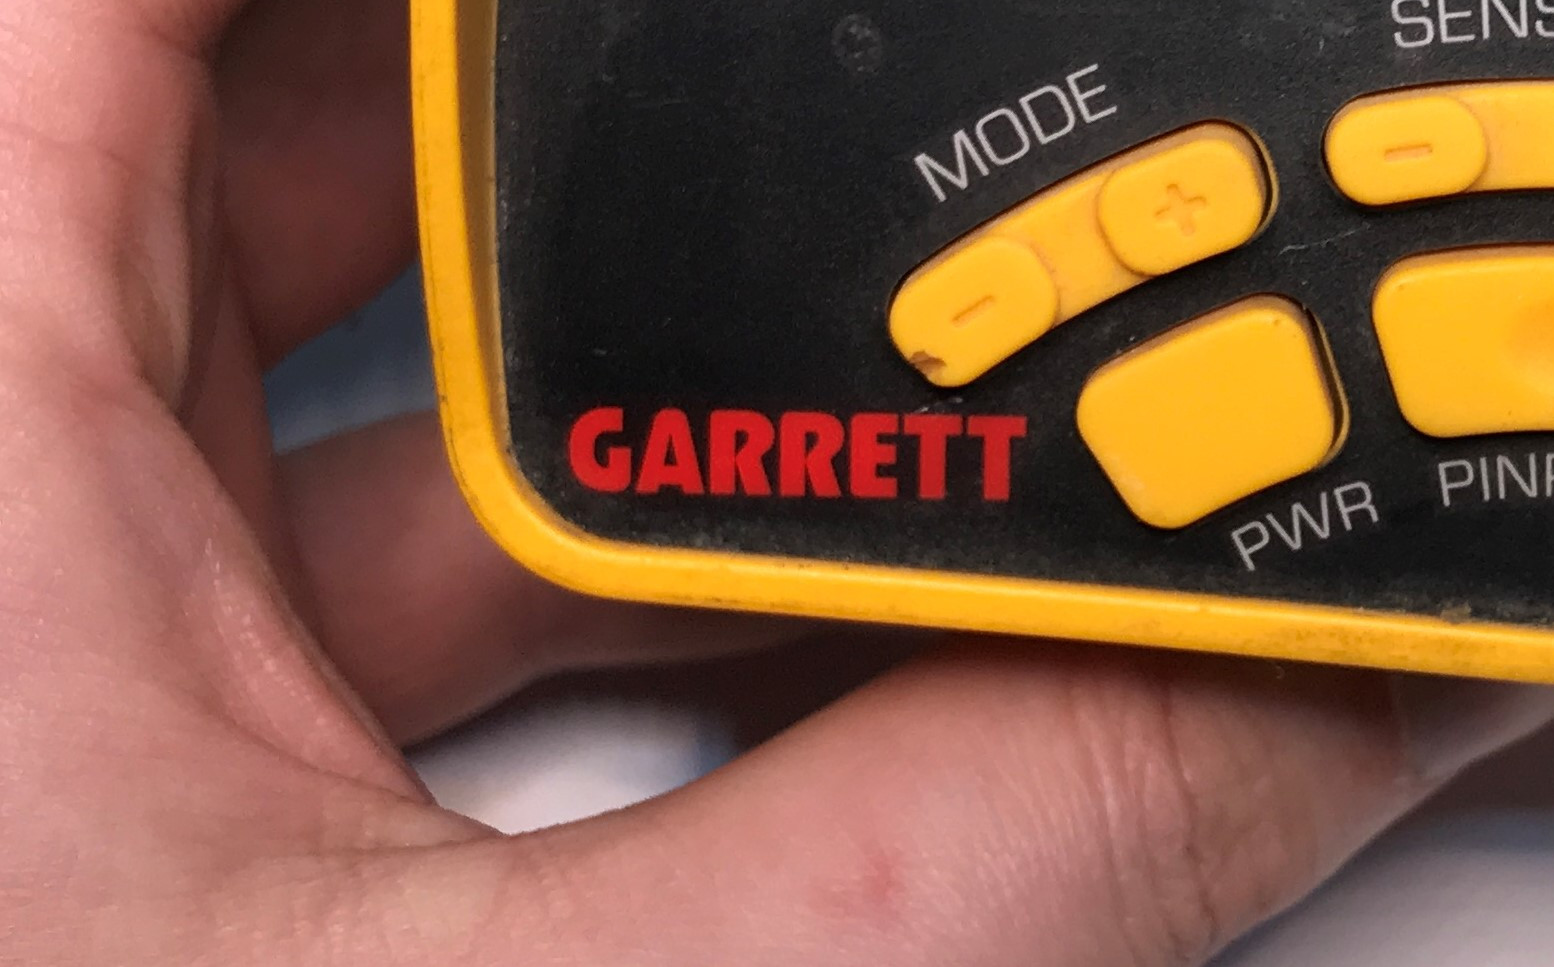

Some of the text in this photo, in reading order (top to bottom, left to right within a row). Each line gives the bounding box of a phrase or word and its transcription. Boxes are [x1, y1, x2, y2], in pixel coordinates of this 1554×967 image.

[913, 63, 1119, 203] MODE
[567, 407, 1028, 503] GARRETT
[1230, 480, 1380, 571] PWR
